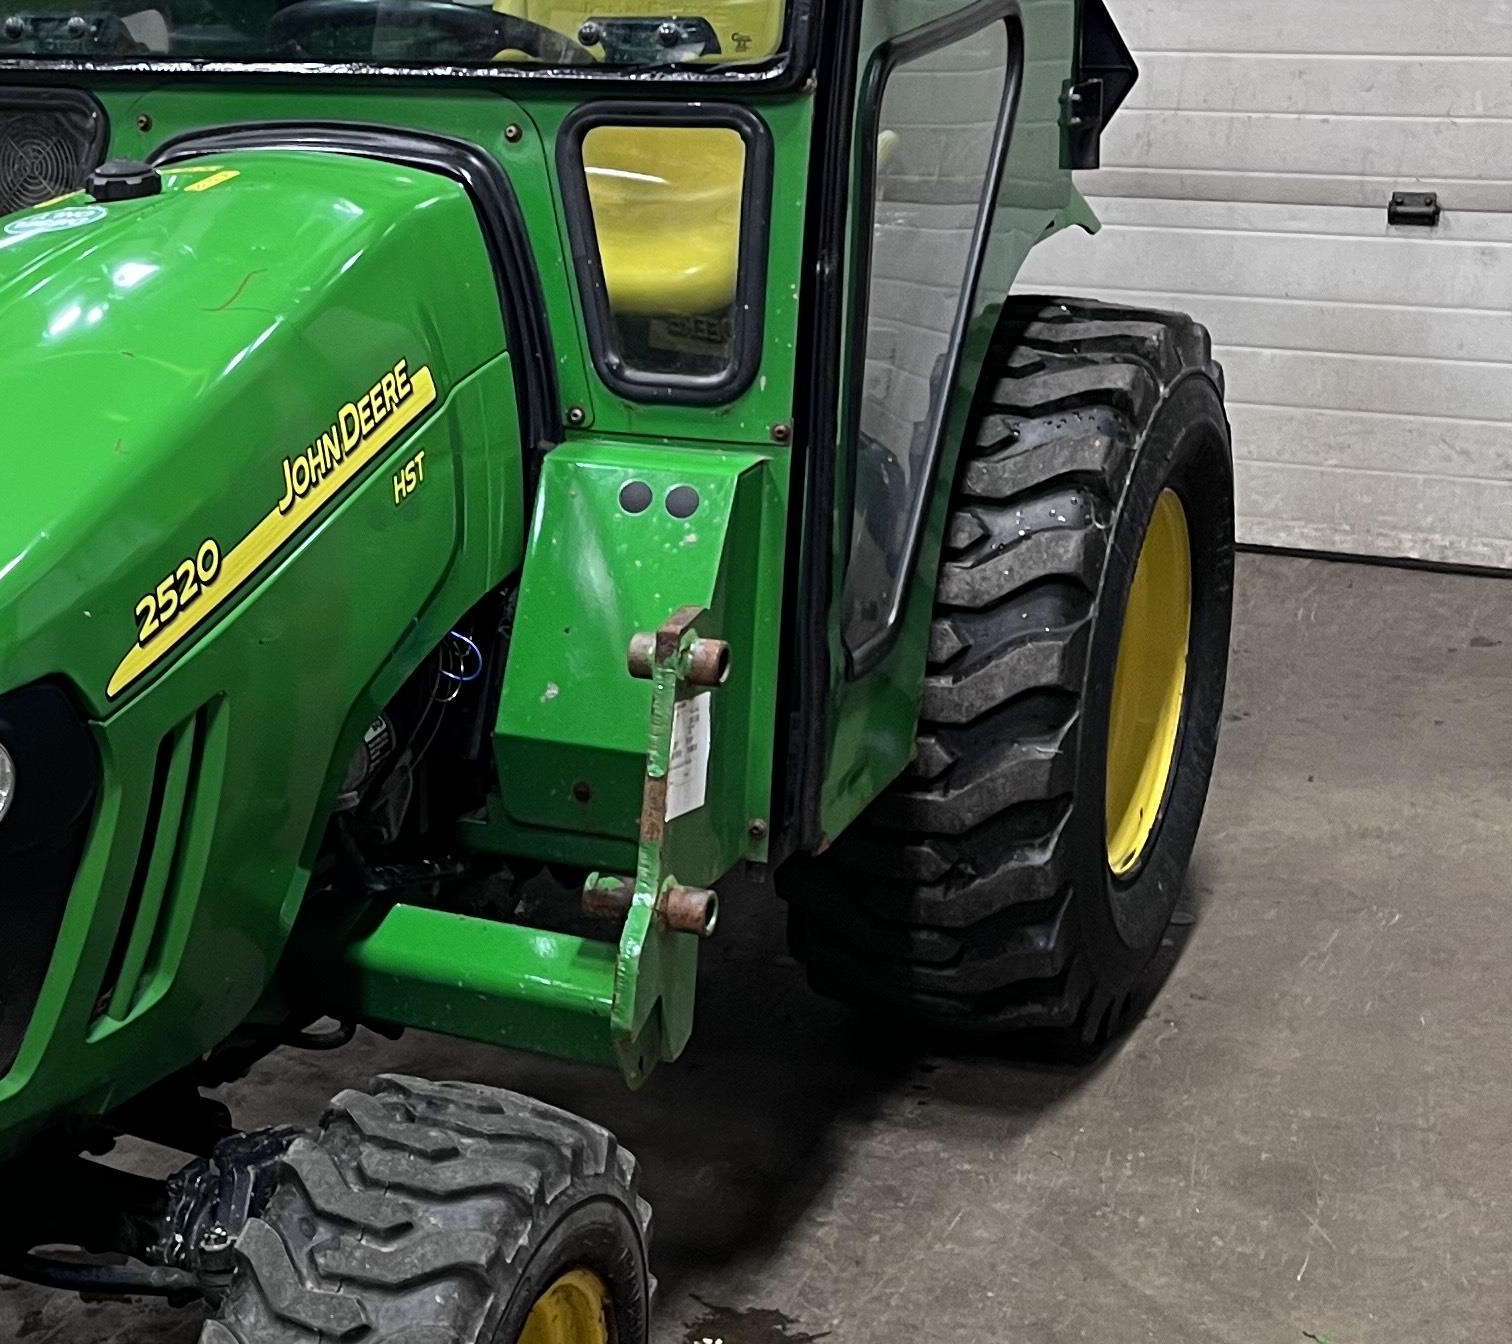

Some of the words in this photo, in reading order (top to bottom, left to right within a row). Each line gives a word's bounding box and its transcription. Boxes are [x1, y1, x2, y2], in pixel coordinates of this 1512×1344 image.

[278, 425, 342, 513] JOHN
[337, 358, 413, 454] DEERE
[392, 450, 426, 504] HST
[134, 538, 220, 643] 2520
